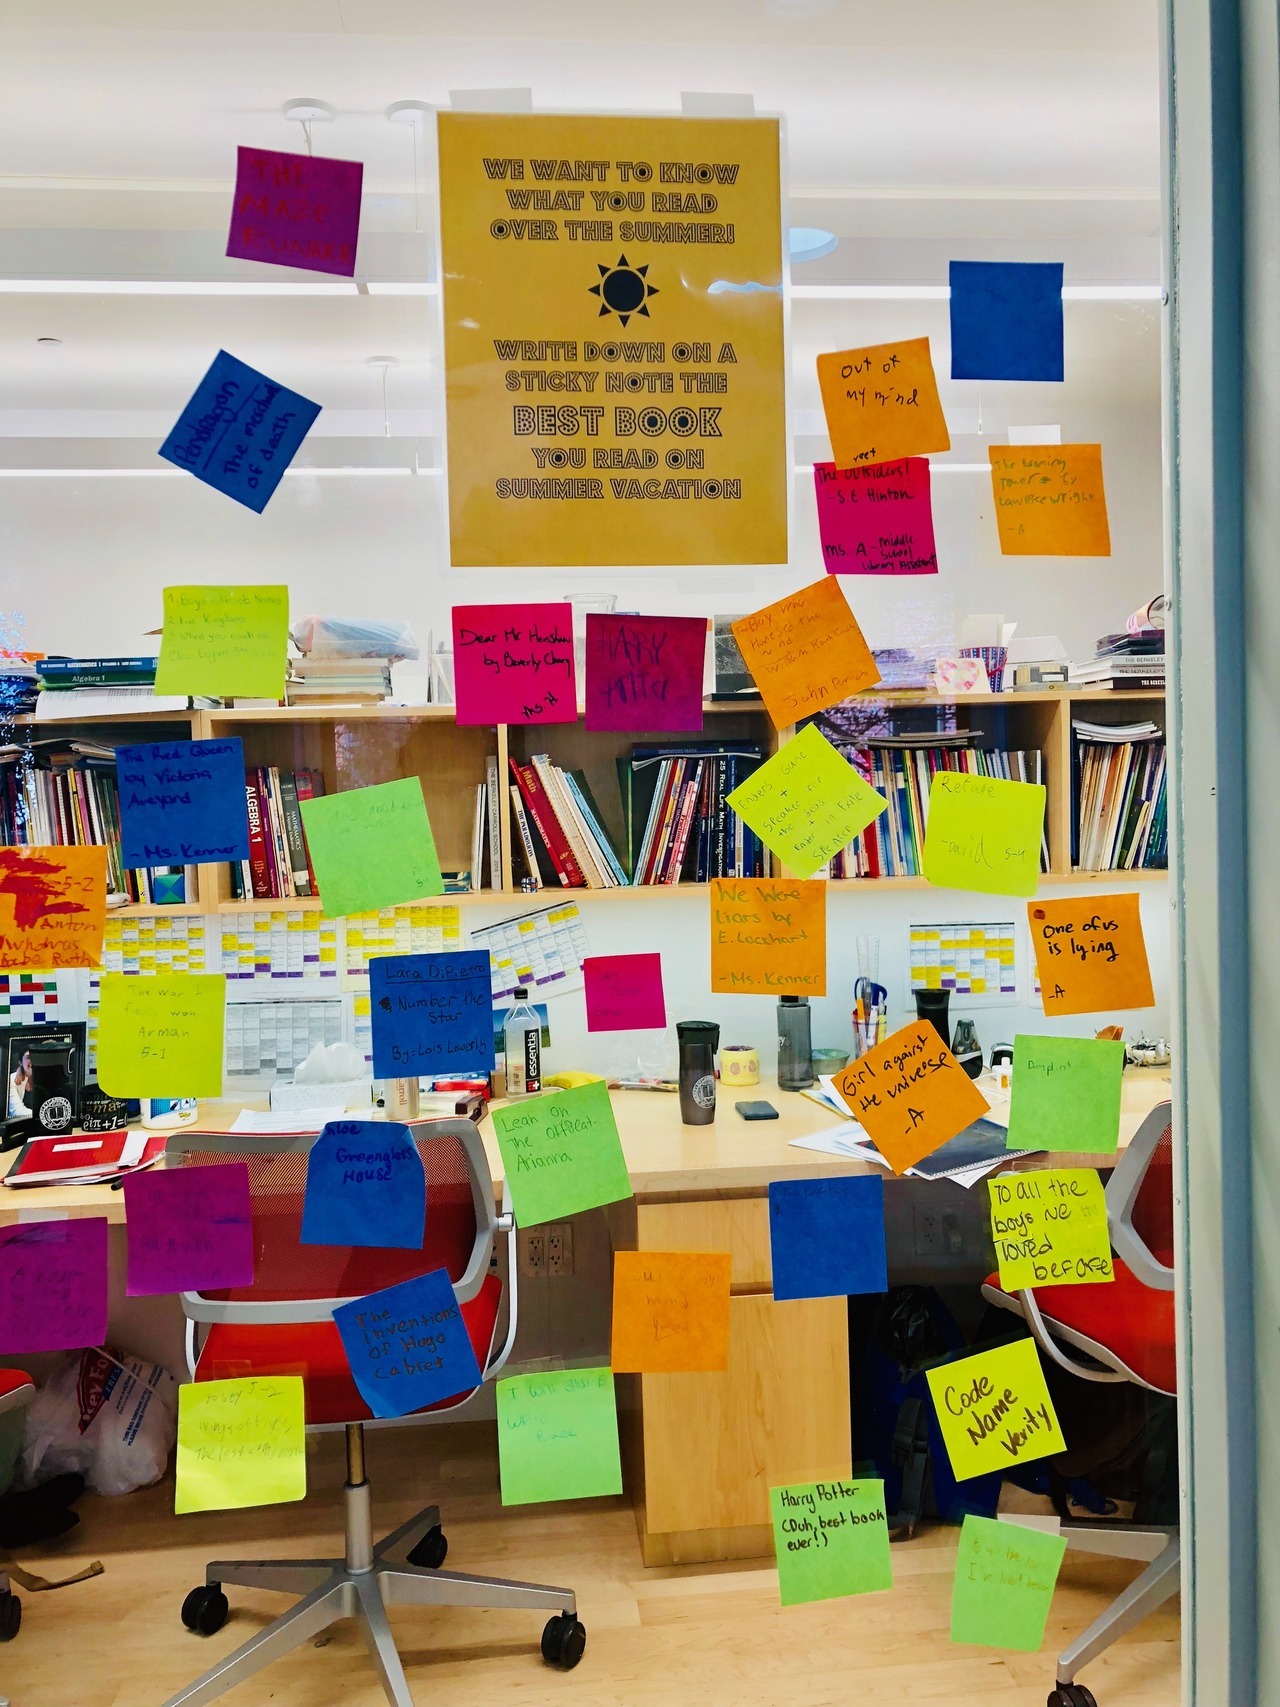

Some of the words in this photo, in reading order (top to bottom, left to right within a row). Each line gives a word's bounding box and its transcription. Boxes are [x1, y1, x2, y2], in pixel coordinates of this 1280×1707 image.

[252, 159, 309, 191] THE
[483, 158, 524, 180] WE
[530, 159, 610, 181] WANT
[617, 161, 653, 182] TO
[659, 163, 740, 184] KNOW
[240, 192, 330, 224] MAZE
[506, 189, 585, 210] WHAT
[590, 191, 645, 211] YOU
[652, 192, 718, 213] READ
[490, 219, 559, 240] OVER
[565, 220, 613, 241] THE
[620, 222, 734, 244] SUMMER!
[494, 340, 577, 361] WRITE
[584, 342, 666, 362] DOWN
[672, 342, 711, 363] ON
[717, 343, 738, 363] A
[505, 371, 599, 392] STICKY
[606, 372, 673, 393] NOTE
[680, 372, 728, 393] THE
[513, 406, 604, 436] BEST
[615, 406, 722, 437] BOOK
[260, 412, 296, 461] death
[531, 448, 586, 468] YOU
[594, 448, 659, 469] READ
[666, 449, 704, 469] ON
[496, 478, 604, 499] SUMMER
[611, 478, 742, 499] VACATION
[867, 488, 914, 502] Hinton
[460, 628, 497, 646] Dear
[483, 653, 500, 674] by
[720, 760, 725, 770] 25
[522, 770, 536, 793] Math
[245, 786, 260, 834] ALGEBRA
[291, 810, 301, 851] MATHEMATICS
[531, 808, 550, 848] MATHEMATICS
[716, 881, 750, 902] We
[40, 914, 96, 931] Anton
[772, 912, 791, 926] by
[1082, 915, 1101, 931] of
[1102, 920, 1118, 931] us
[1048, 942, 1062, 955] is
[1071, 937, 1119, 962] lying
[386, 963, 422, 979] Lara
[765, 972, 820, 985] Kenner
[398, 994, 458, 1011] Number
[138, 1026, 190, 1038] Arman
[141, 1046, 166, 1059] 5-1
[529, 1032, 537, 1076] essentia
[842, 1061, 876, 1096] Girl
[501, 1114, 538, 1132] Leah
[517, 1152, 572, 1172] Arianna
[1048, 1179, 1088, 1197] the
[994, 1212, 1034, 1237] boys
[1002, 1233, 1053, 1262] loved
[357, 1310, 393, 1328] The
[945, 1376, 994, 1415] Code
[966, 1388, 1018, 1446] Name
[1000, 1403, 1052, 1456] Verity
[781, 1490, 816, 1513] Harry
[816, 1482, 859, 1500] Potter
[819, 1512, 847, 1529] best
